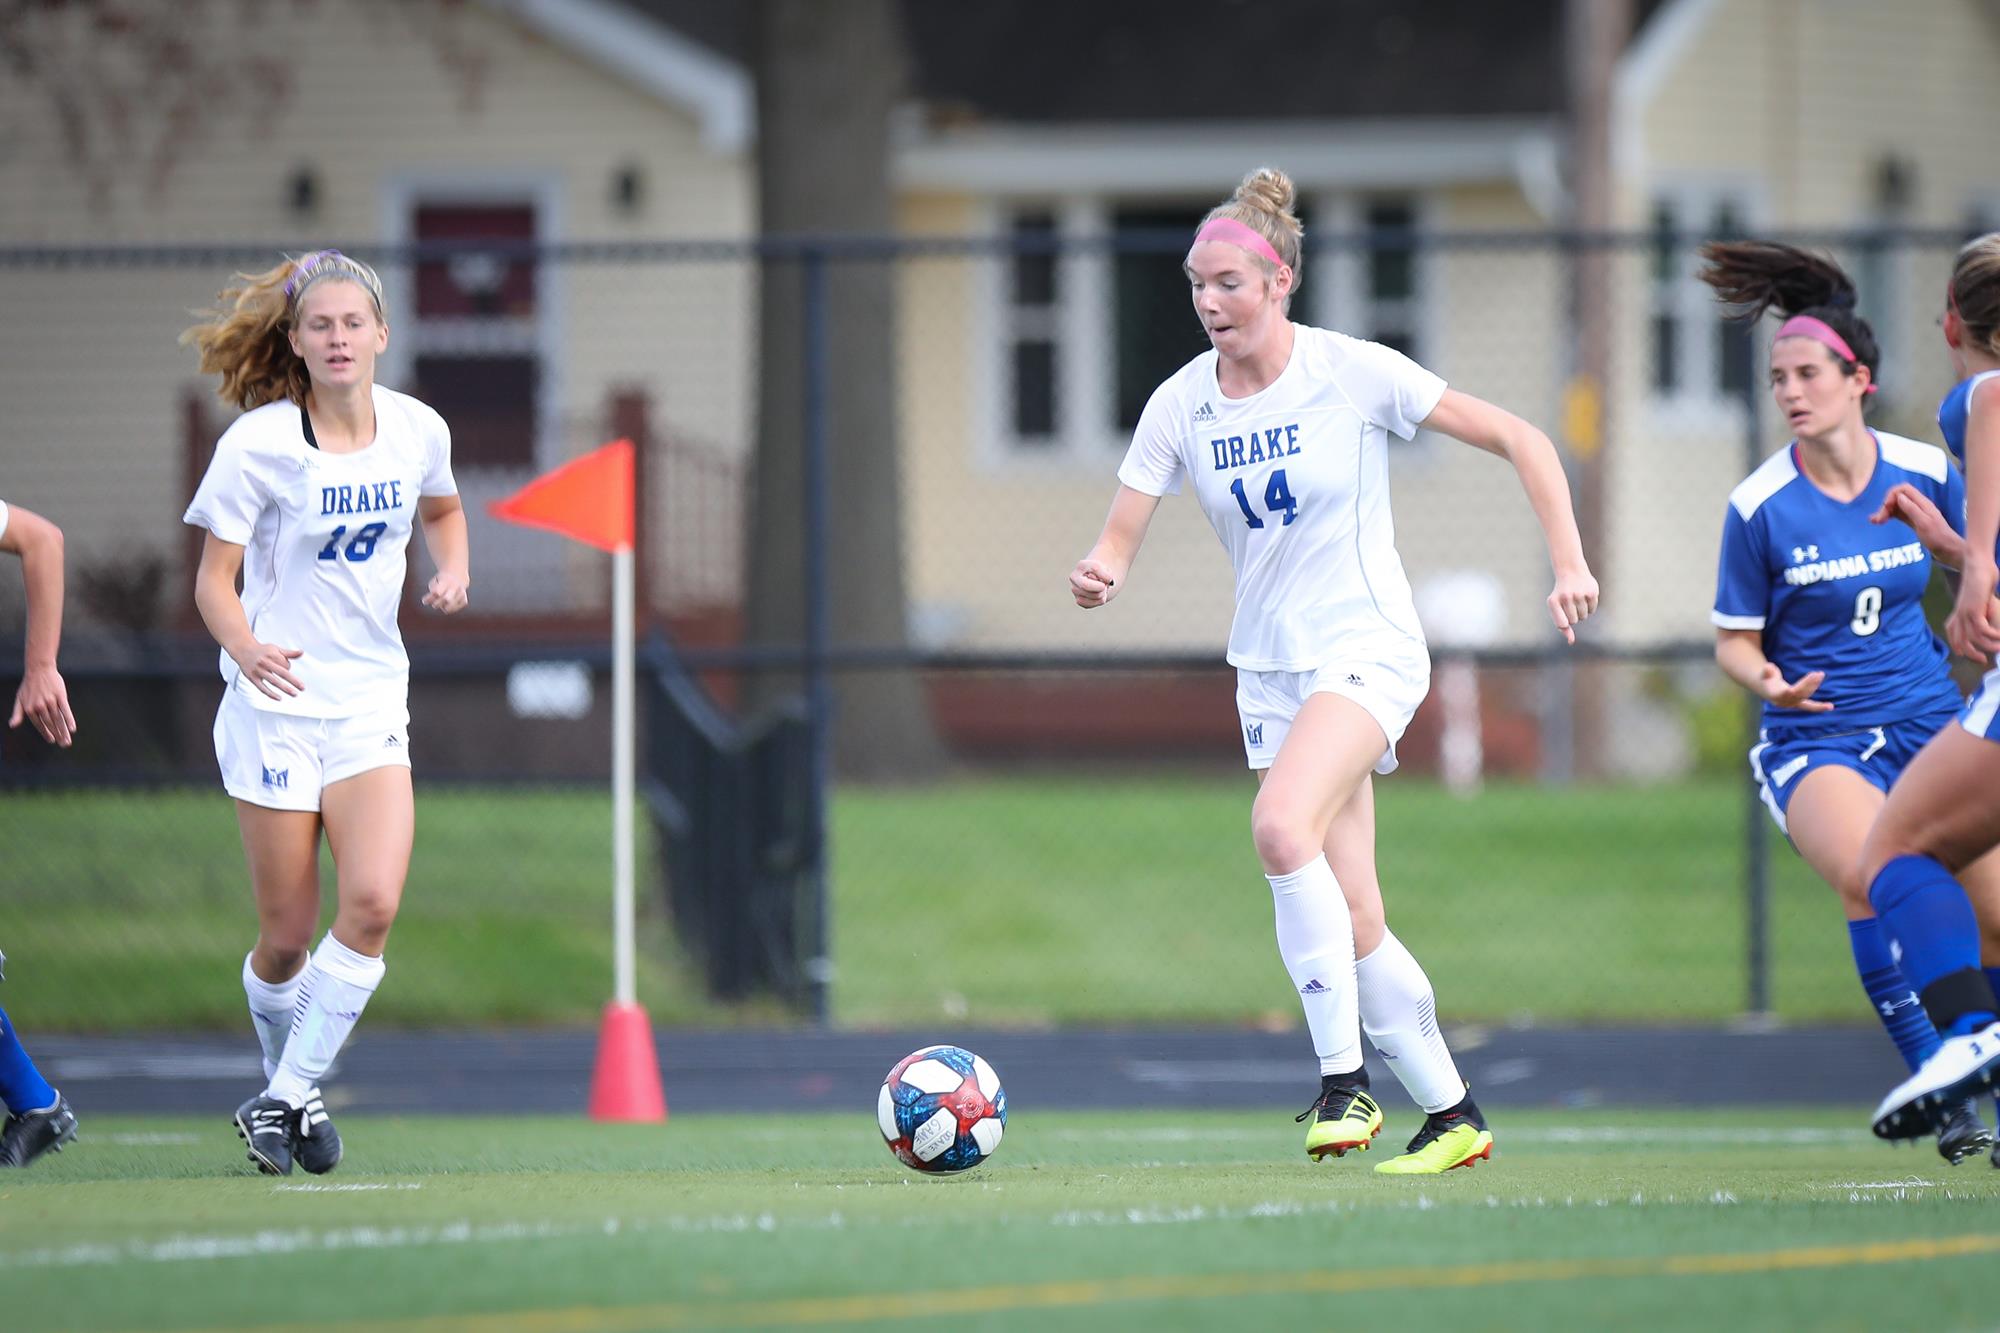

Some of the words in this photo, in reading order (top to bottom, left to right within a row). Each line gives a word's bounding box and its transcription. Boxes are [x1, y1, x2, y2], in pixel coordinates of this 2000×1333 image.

[1211, 424, 1301, 470] DRAKE
[321, 480, 402, 516] DRAKE
[1230, 469, 1299, 529] 14
[318, 522, 388, 562] 18
[1784, 554, 1869, 586] INDIANA
[1868, 542, 1925, 572] STATE
